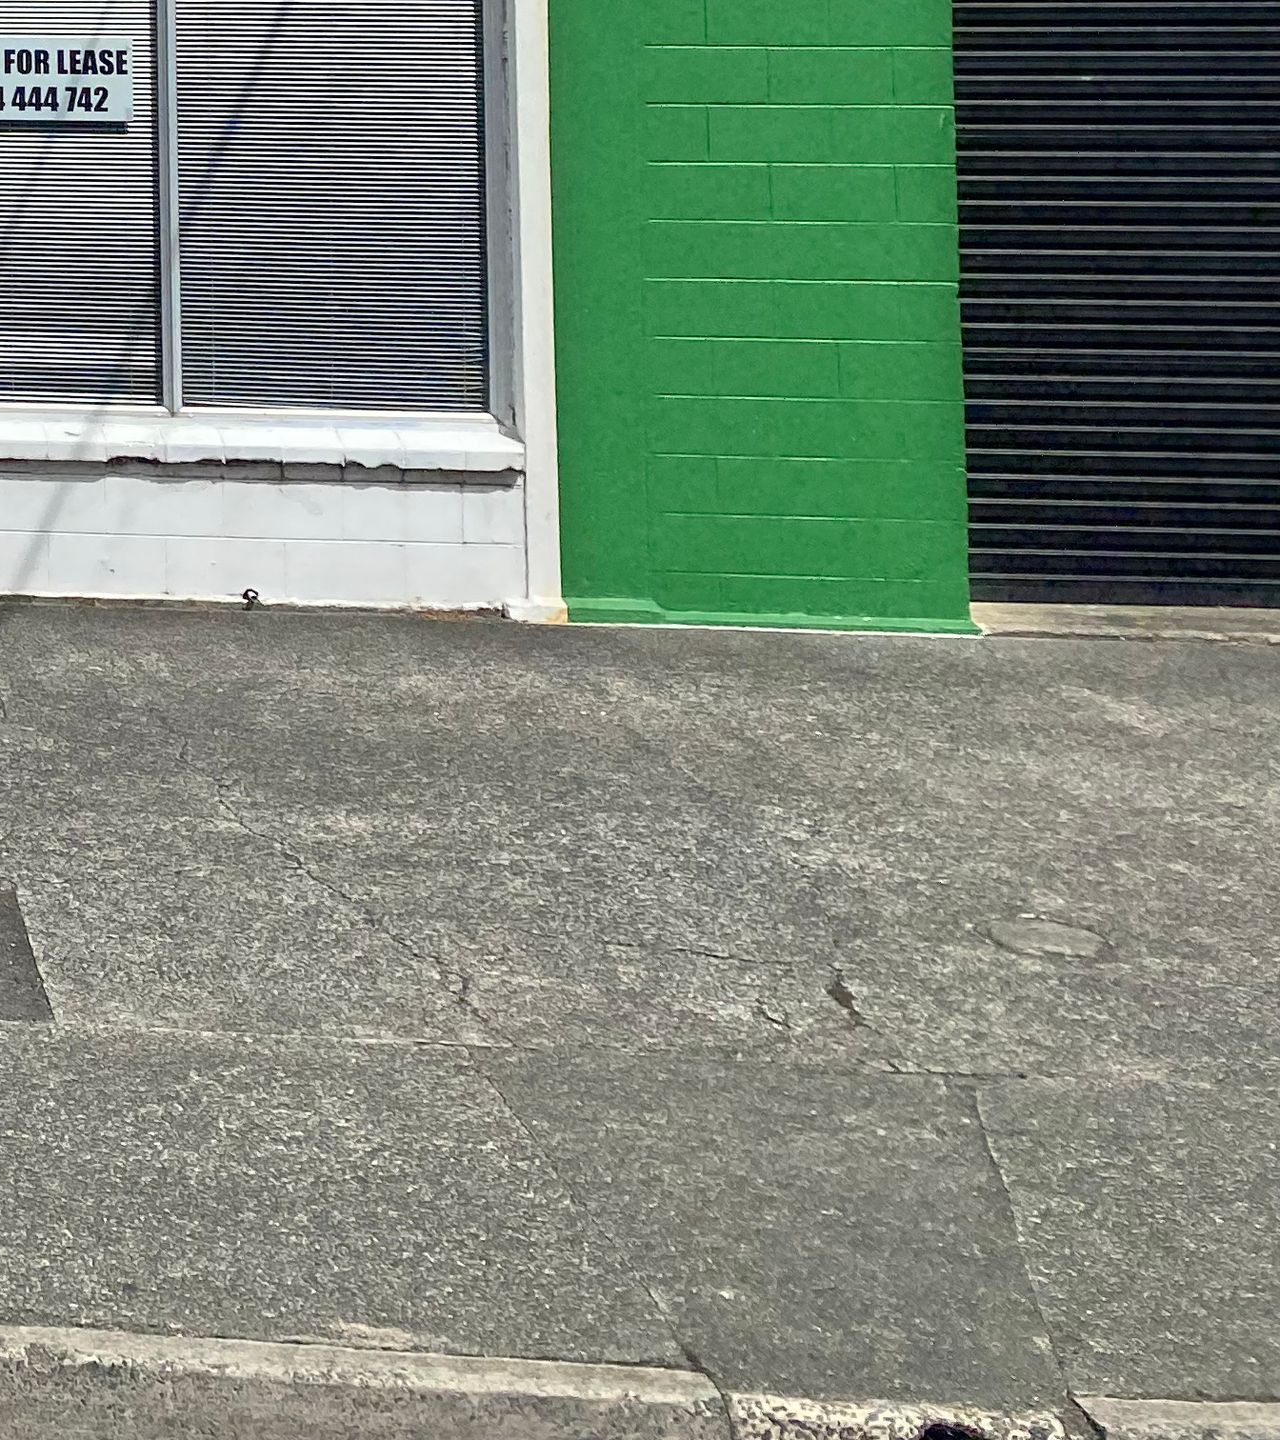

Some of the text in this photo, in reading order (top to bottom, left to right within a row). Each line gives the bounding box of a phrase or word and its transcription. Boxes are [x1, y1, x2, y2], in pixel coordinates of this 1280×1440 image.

[4, 49, 50, 75] FOR
[57, 49, 128, 76] LEASE
[11, 86, 59, 111] 444
[65, 86, 109, 112] 742
